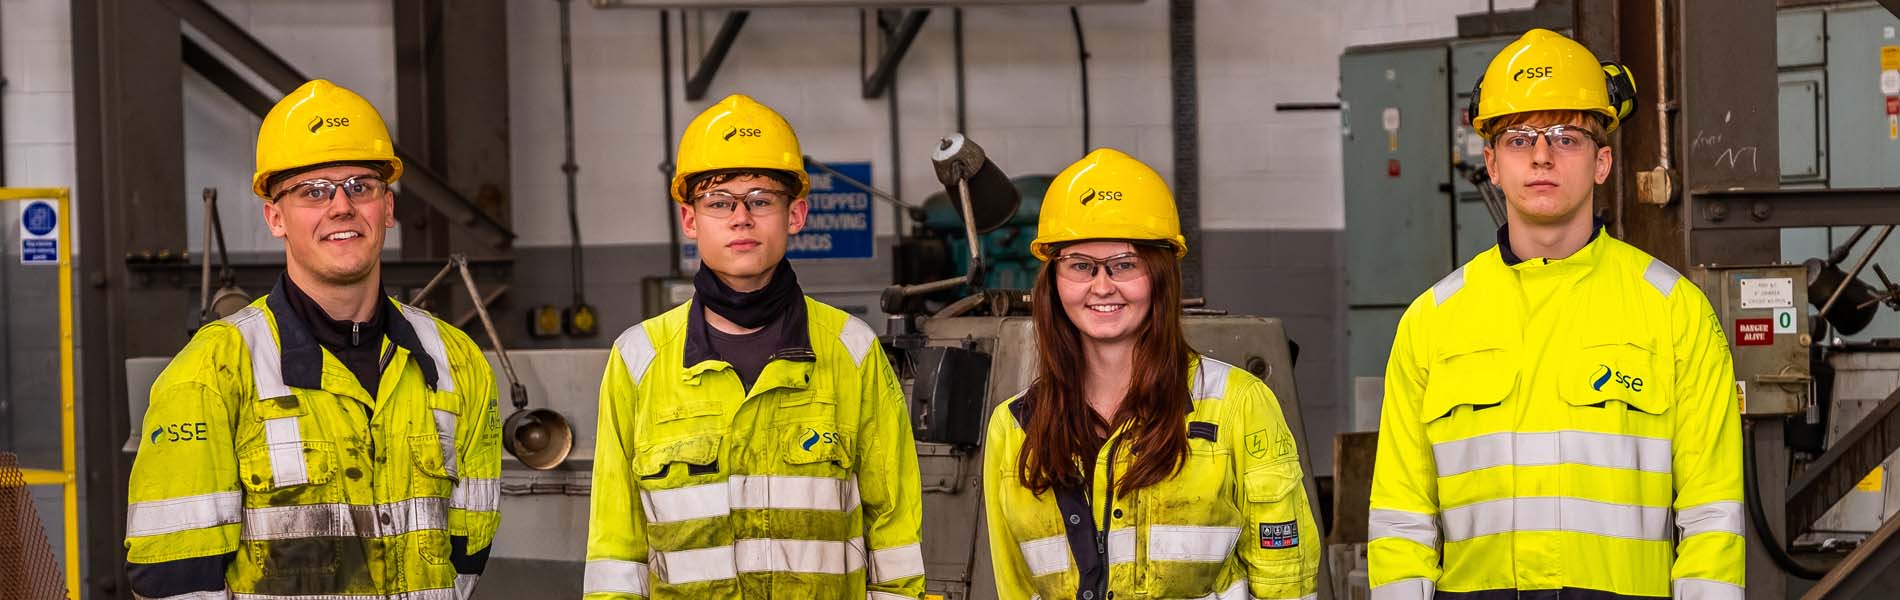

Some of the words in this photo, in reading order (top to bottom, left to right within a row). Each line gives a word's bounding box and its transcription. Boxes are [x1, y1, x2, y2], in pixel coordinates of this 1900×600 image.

[1526, 66, 1553, 79] SSE
[326, 117, 350, 128] sse
[739, 128, 762, 138] sse
[809, 173, 833, 189] INE
[808, 192, 868, 210] STOPPED
[1098, 190, 1123, 201] sse
[806, 213, 867, 230] MOVING
[788, 233, 833, 251] ARDS
[1739, 324, 1769, 333] DANGER
[1744, 333, 1766, 342] ALIVE
[1615, 371, 1644, 392] sse
[167, 422, 208, 442] SSE
[822, 432, 839, 446] ss
